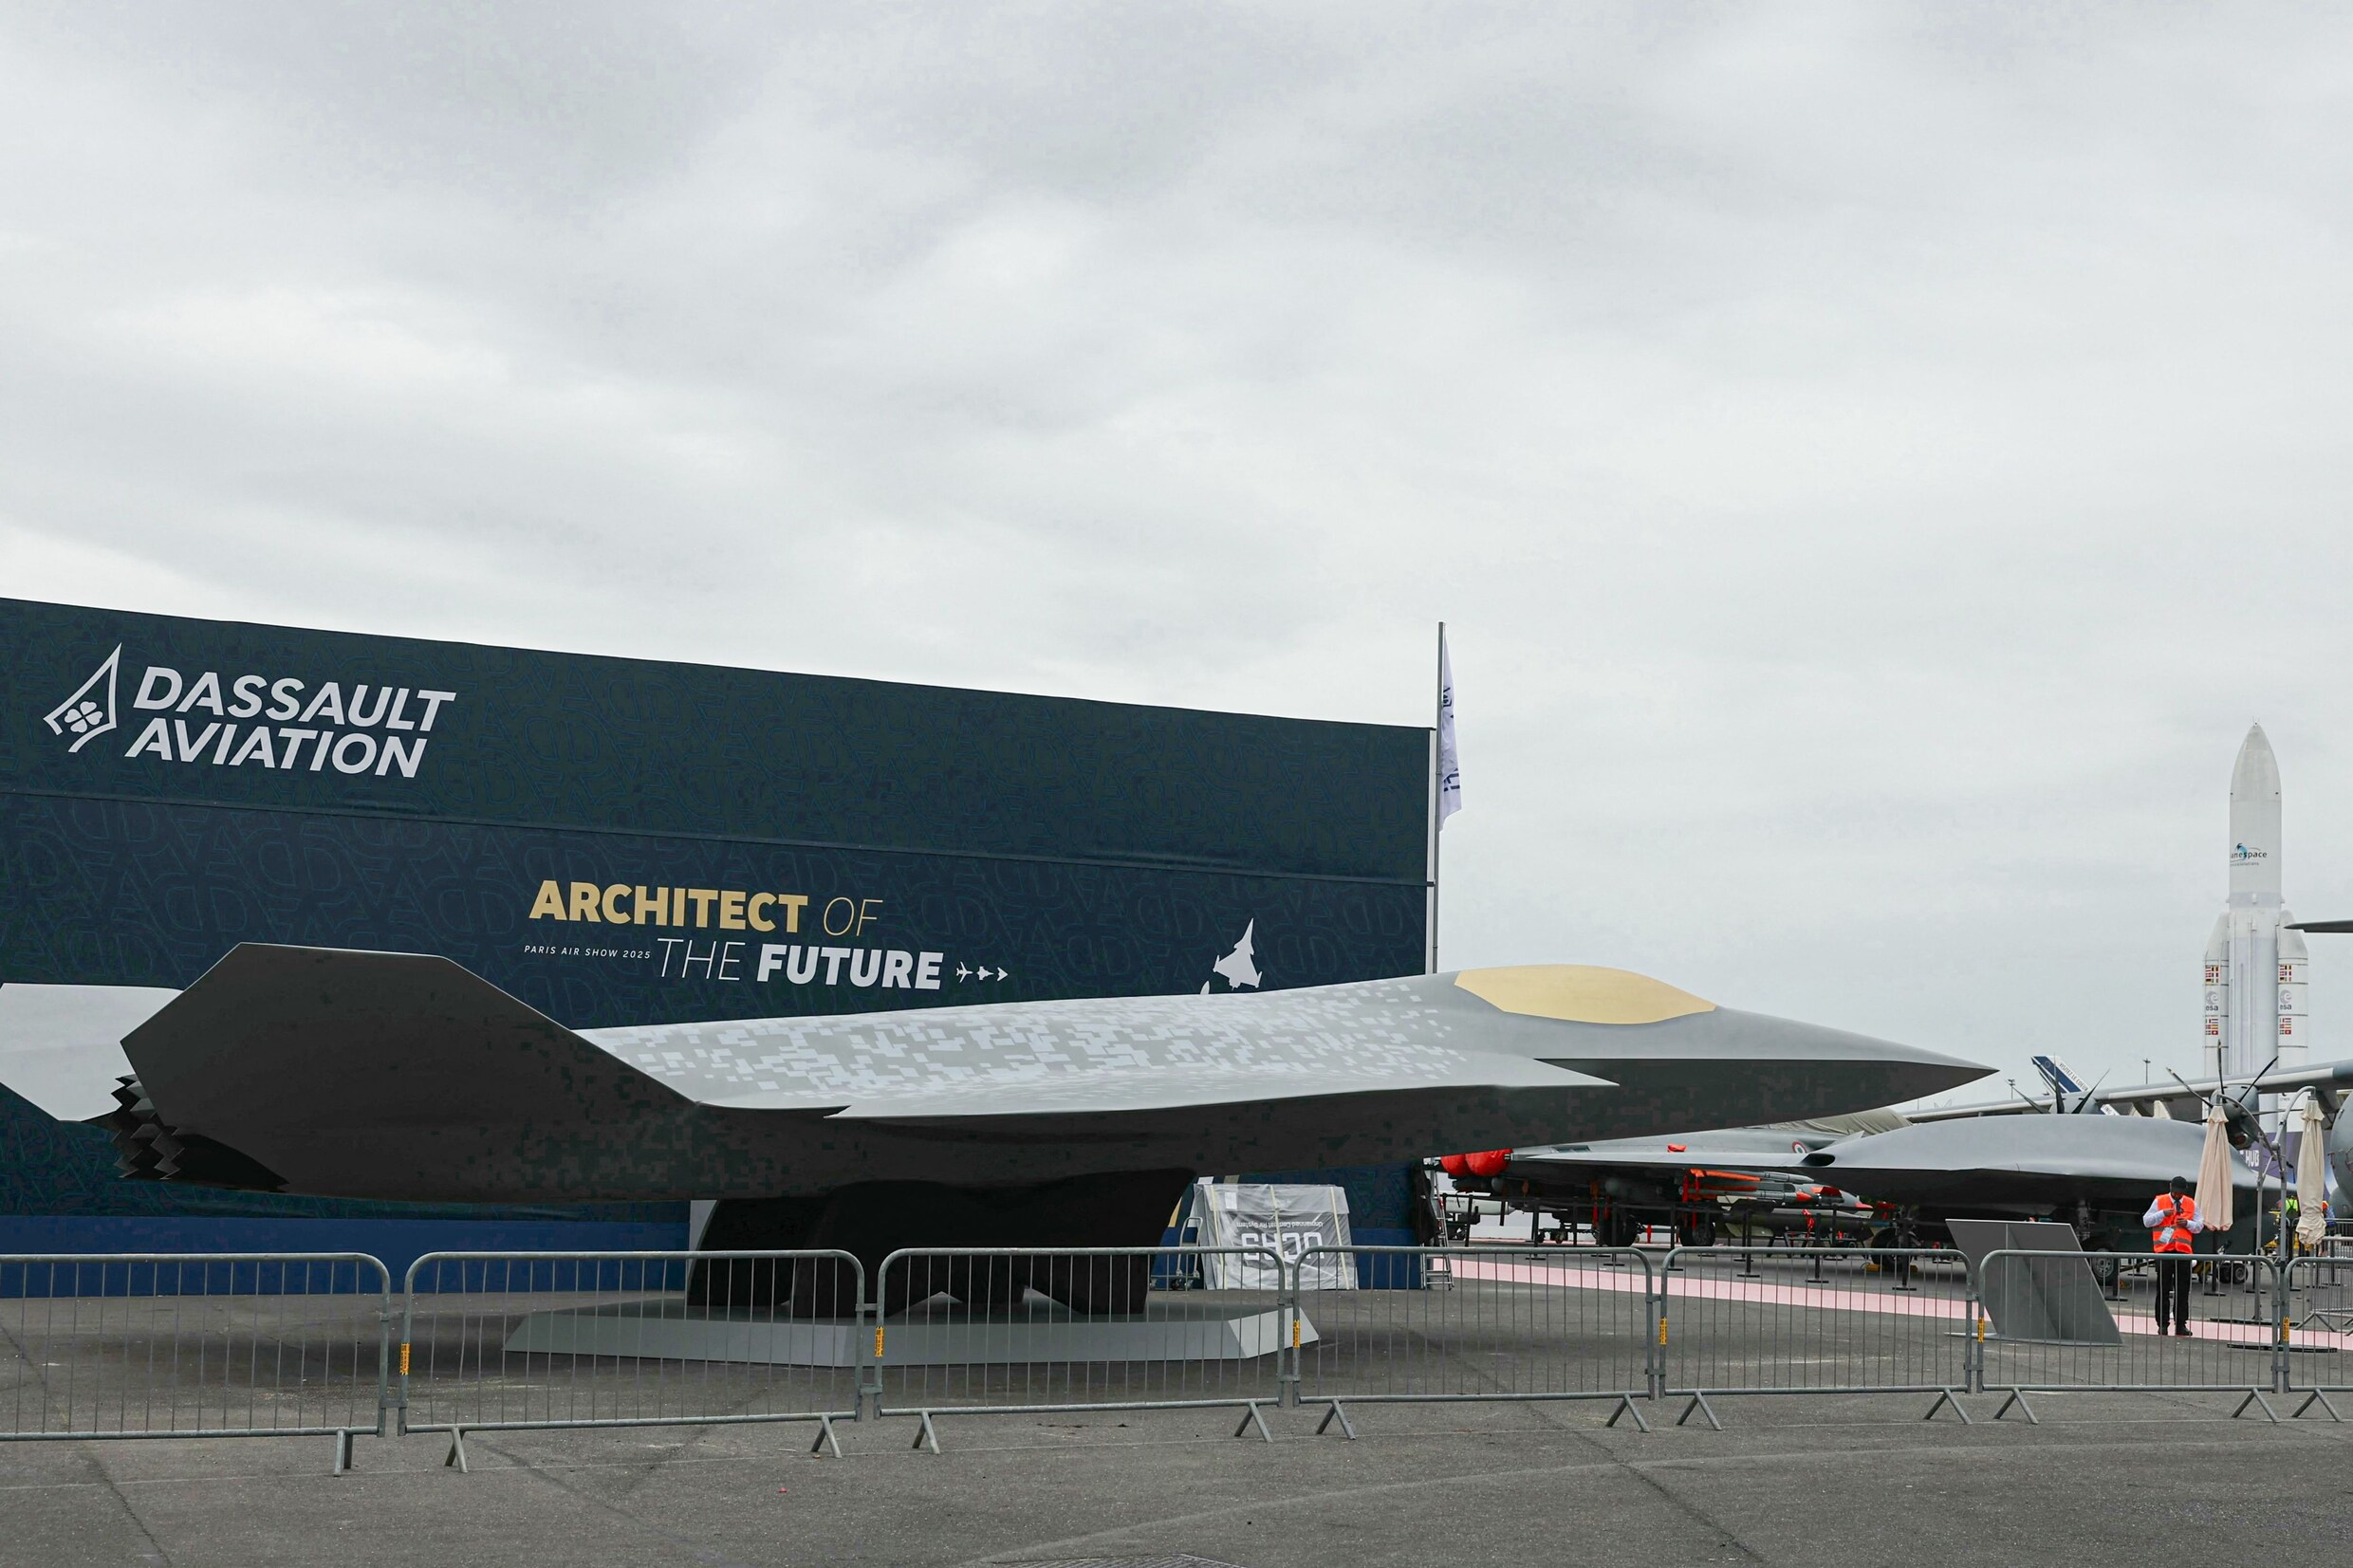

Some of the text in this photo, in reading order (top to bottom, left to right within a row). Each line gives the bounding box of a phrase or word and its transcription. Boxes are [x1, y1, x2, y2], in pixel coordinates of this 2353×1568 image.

[134, 667, 456, 731] DASSAULT
[124, 718, 427, 778] AVIATION
[528, 880, 883, 936] ARCHITECT OF
[524, 945, 652, 959] PARIS AIR SHOW 2025
[658, 937, 944, 990] THE FUTURE
[2245, 1150, 2260, 1167] HUB
[1241, 1231, 1325, 1260] UCAS
